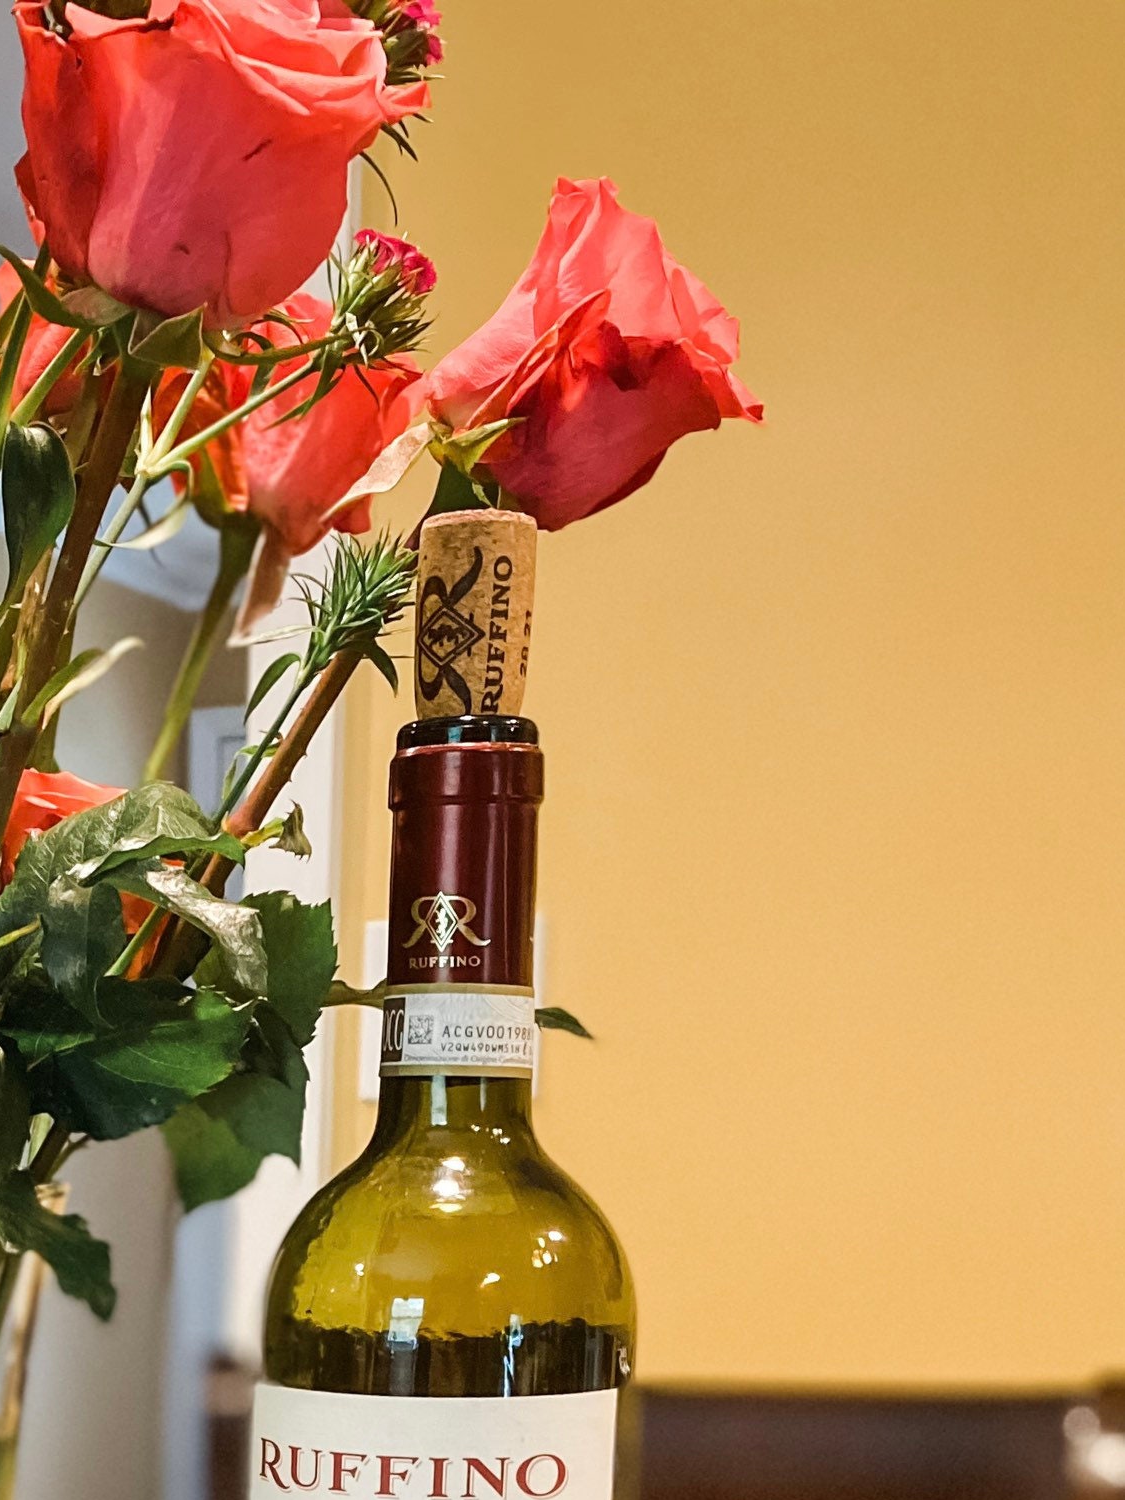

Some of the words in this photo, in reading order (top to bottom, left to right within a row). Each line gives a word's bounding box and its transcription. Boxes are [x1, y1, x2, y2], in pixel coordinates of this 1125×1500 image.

[481, 555, 513, 713] RUFFINO
[409, 955, 481, 970] RUFFINO
[259, 1437, 569, 1500] RUFFINO
